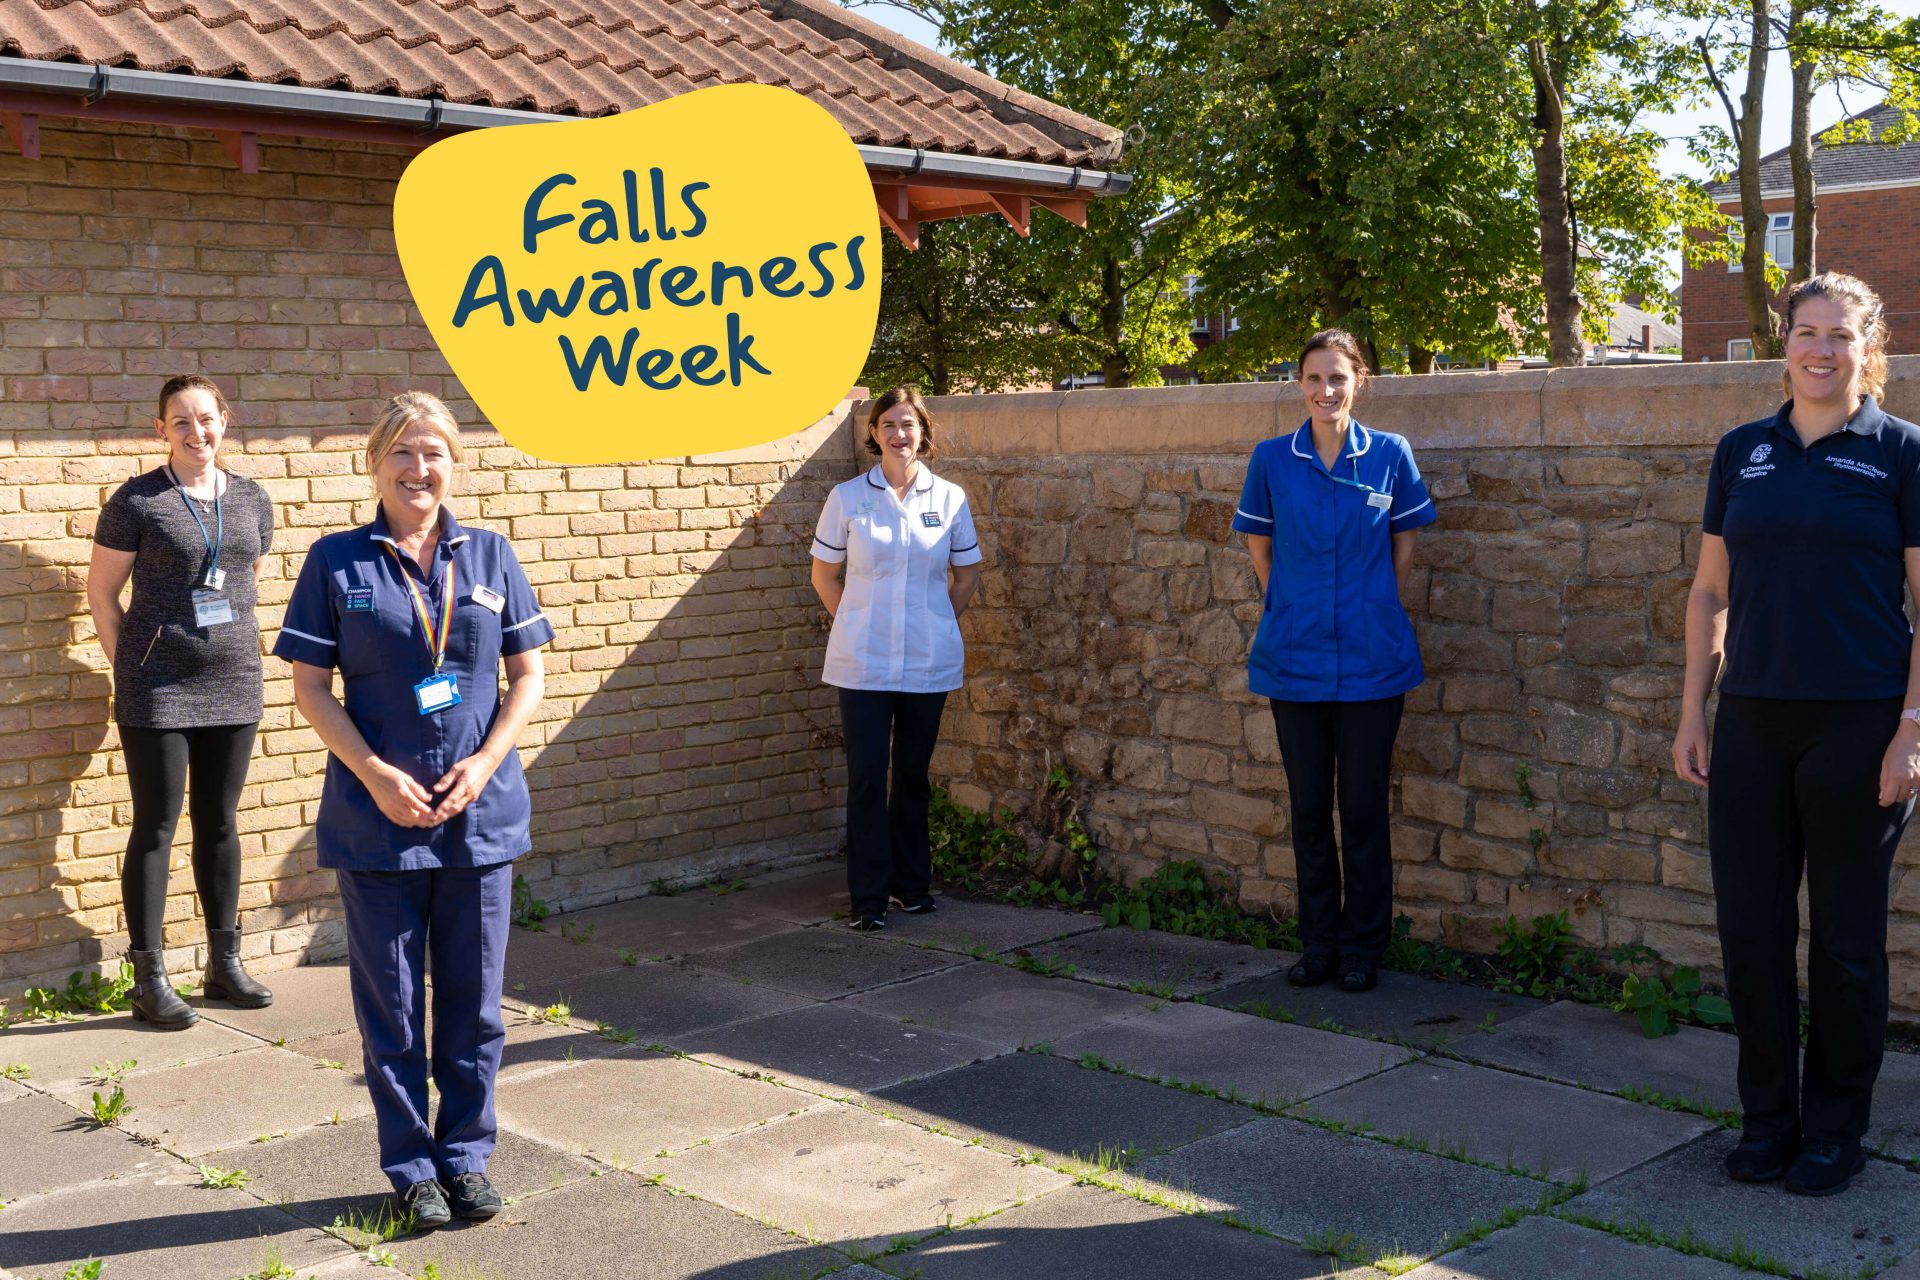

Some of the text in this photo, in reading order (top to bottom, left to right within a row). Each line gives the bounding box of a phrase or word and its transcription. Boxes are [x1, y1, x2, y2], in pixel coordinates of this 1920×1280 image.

[1824, 455, 1855, 466] Amanda
[1746, 463, 1775, 473] Oswald's
[1742, 470, 1768, 480] Hospice
